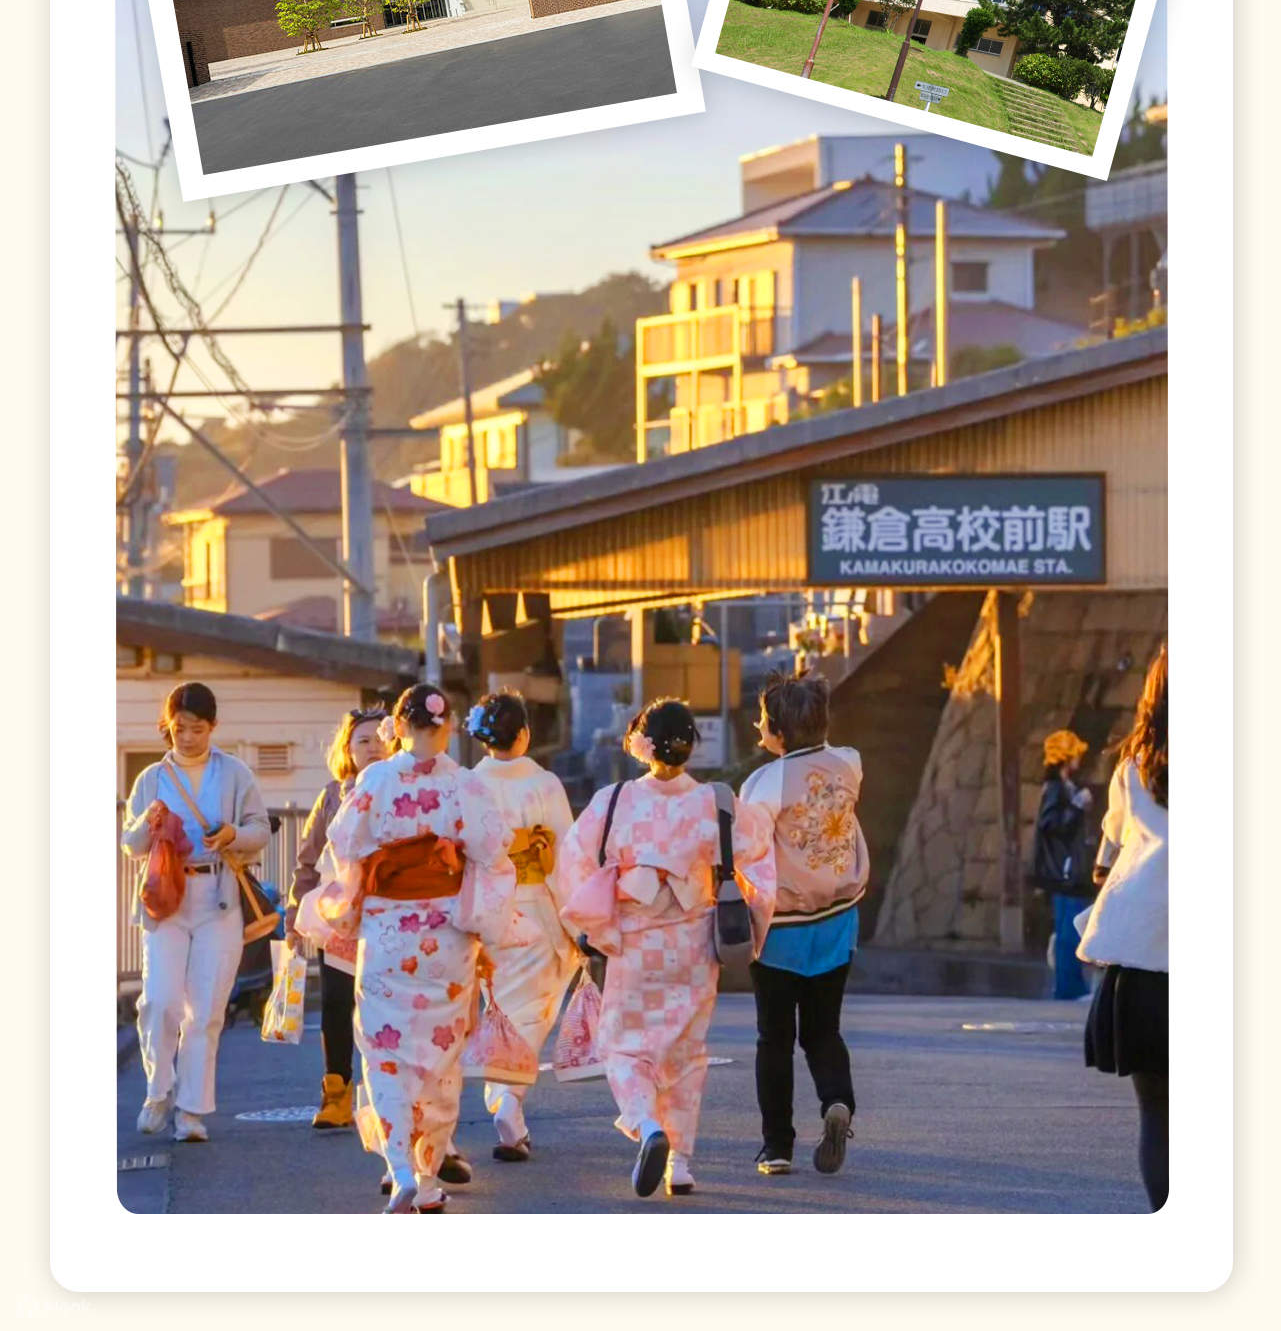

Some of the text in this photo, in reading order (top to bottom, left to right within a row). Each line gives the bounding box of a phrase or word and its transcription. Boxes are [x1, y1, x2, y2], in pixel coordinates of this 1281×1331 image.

[821, 505, 1092, 553] 鎌倉高校前駅
[839, 559, 1073, 575] KAMAKURAKOKOMAE STA.
